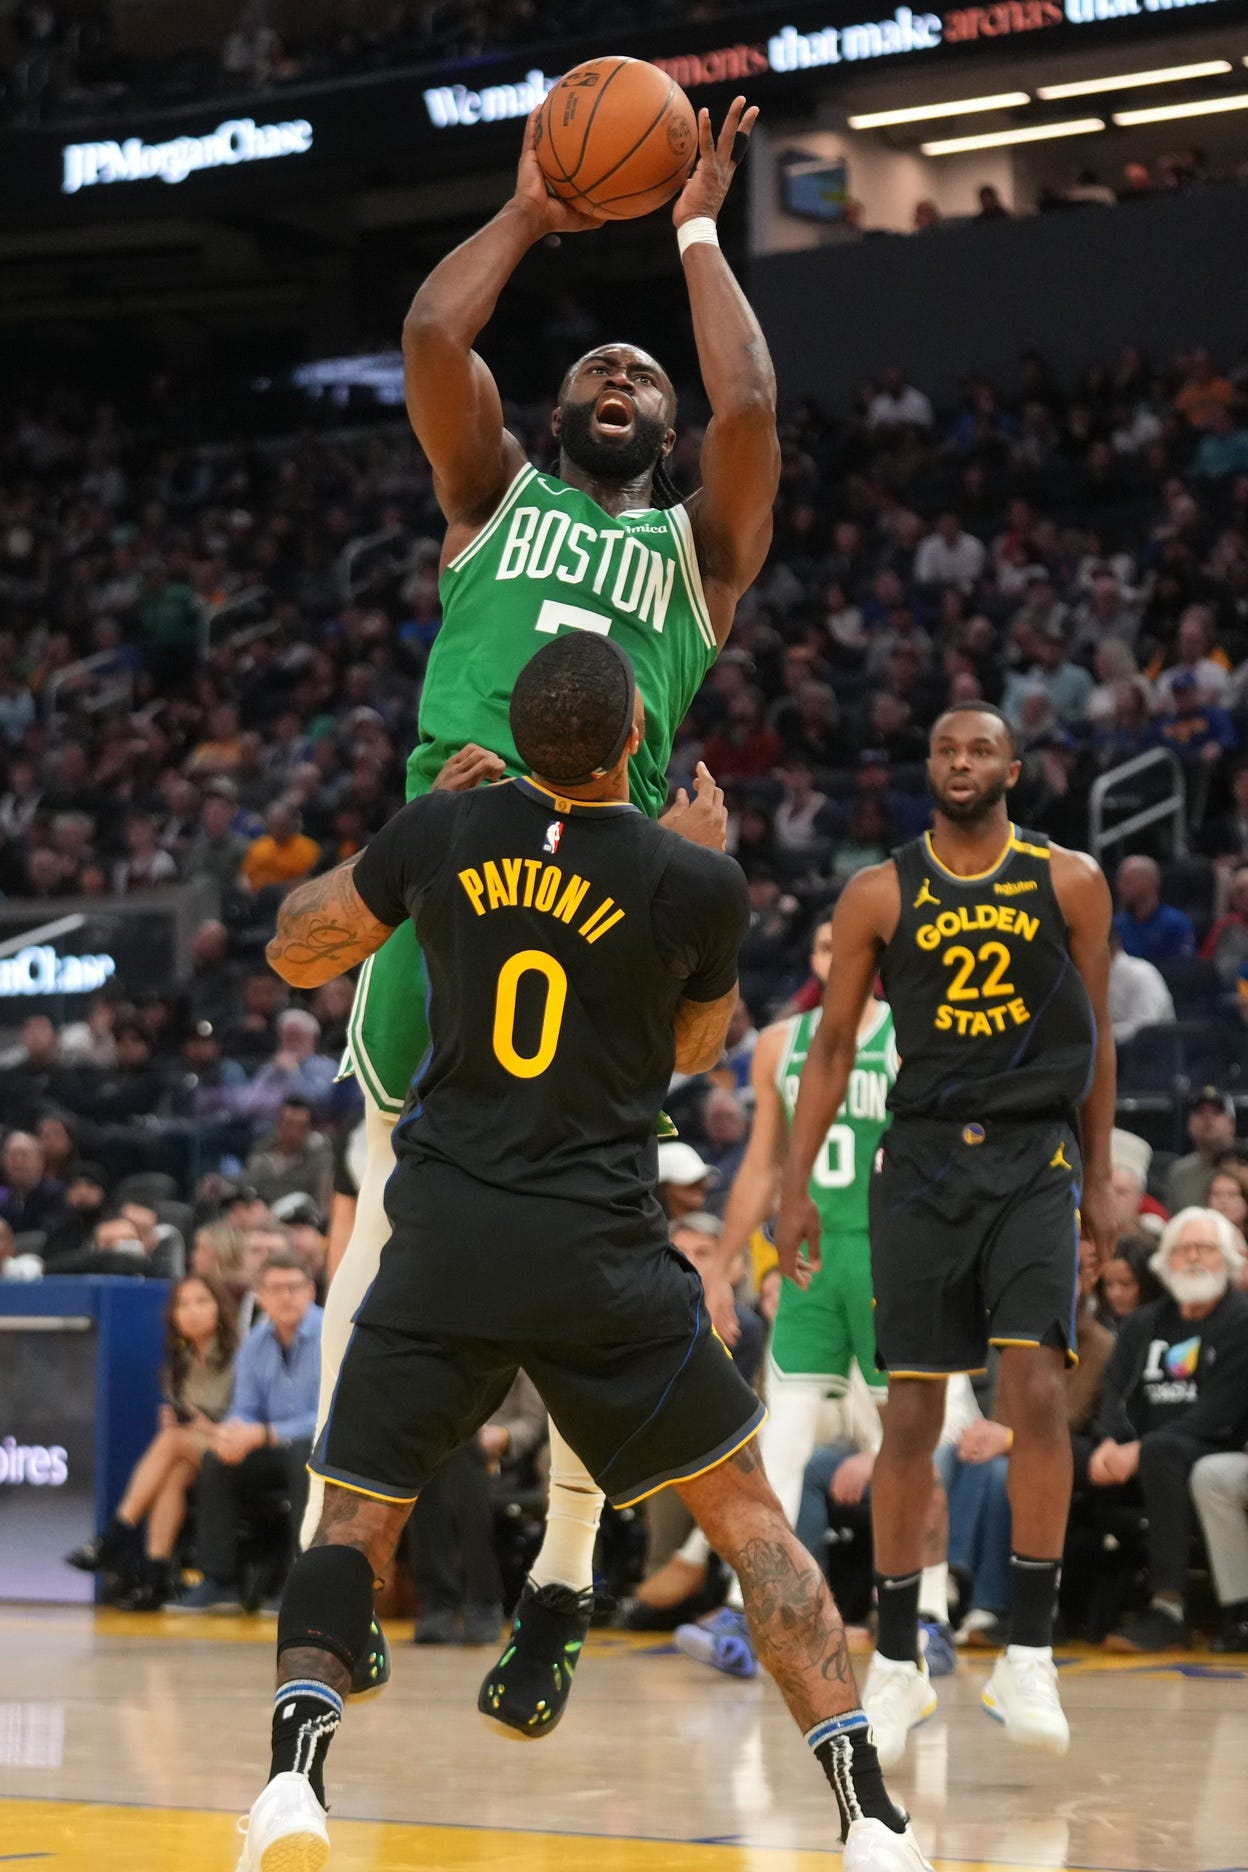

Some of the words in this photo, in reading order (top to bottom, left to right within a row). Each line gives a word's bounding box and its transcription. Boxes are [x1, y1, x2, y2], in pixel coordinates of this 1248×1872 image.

[480, 69, 562, 122] mak
[496, 506, 675, 634] BOSTON
[457, 858, 591, 924] PAYTON
[578, 897, 626, 944] II
[994, 880, 1038, 896] Rakuten
[916, 904, 1040, 950] GOLDEN
[943, 941, 1015, 1001] 22
[493, 950, 567, 1079] 0
[935, 997, 1031, 1036] STATE
